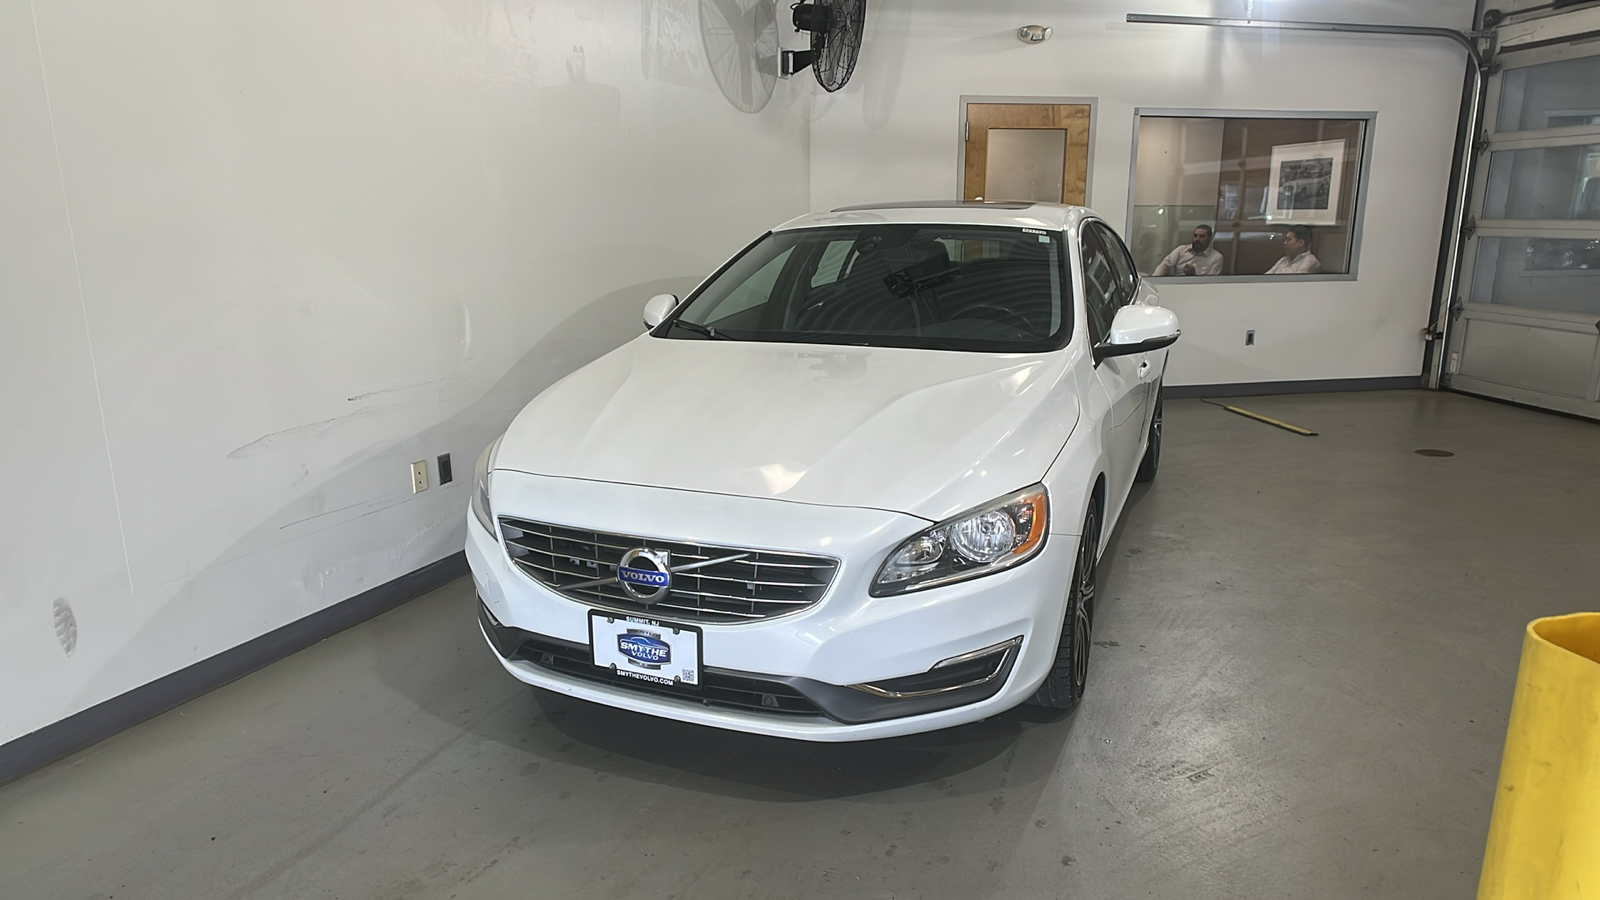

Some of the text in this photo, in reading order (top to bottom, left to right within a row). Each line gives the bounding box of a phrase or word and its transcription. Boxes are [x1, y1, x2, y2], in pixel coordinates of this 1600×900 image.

[620, 570, 665, 583] VOLVO
[620, 642, 667, 657] SMYTHE
[631, 650, 659, 661] VOLVO
[616, 669, 674, 686] SMYTHEVOLVO.COM
